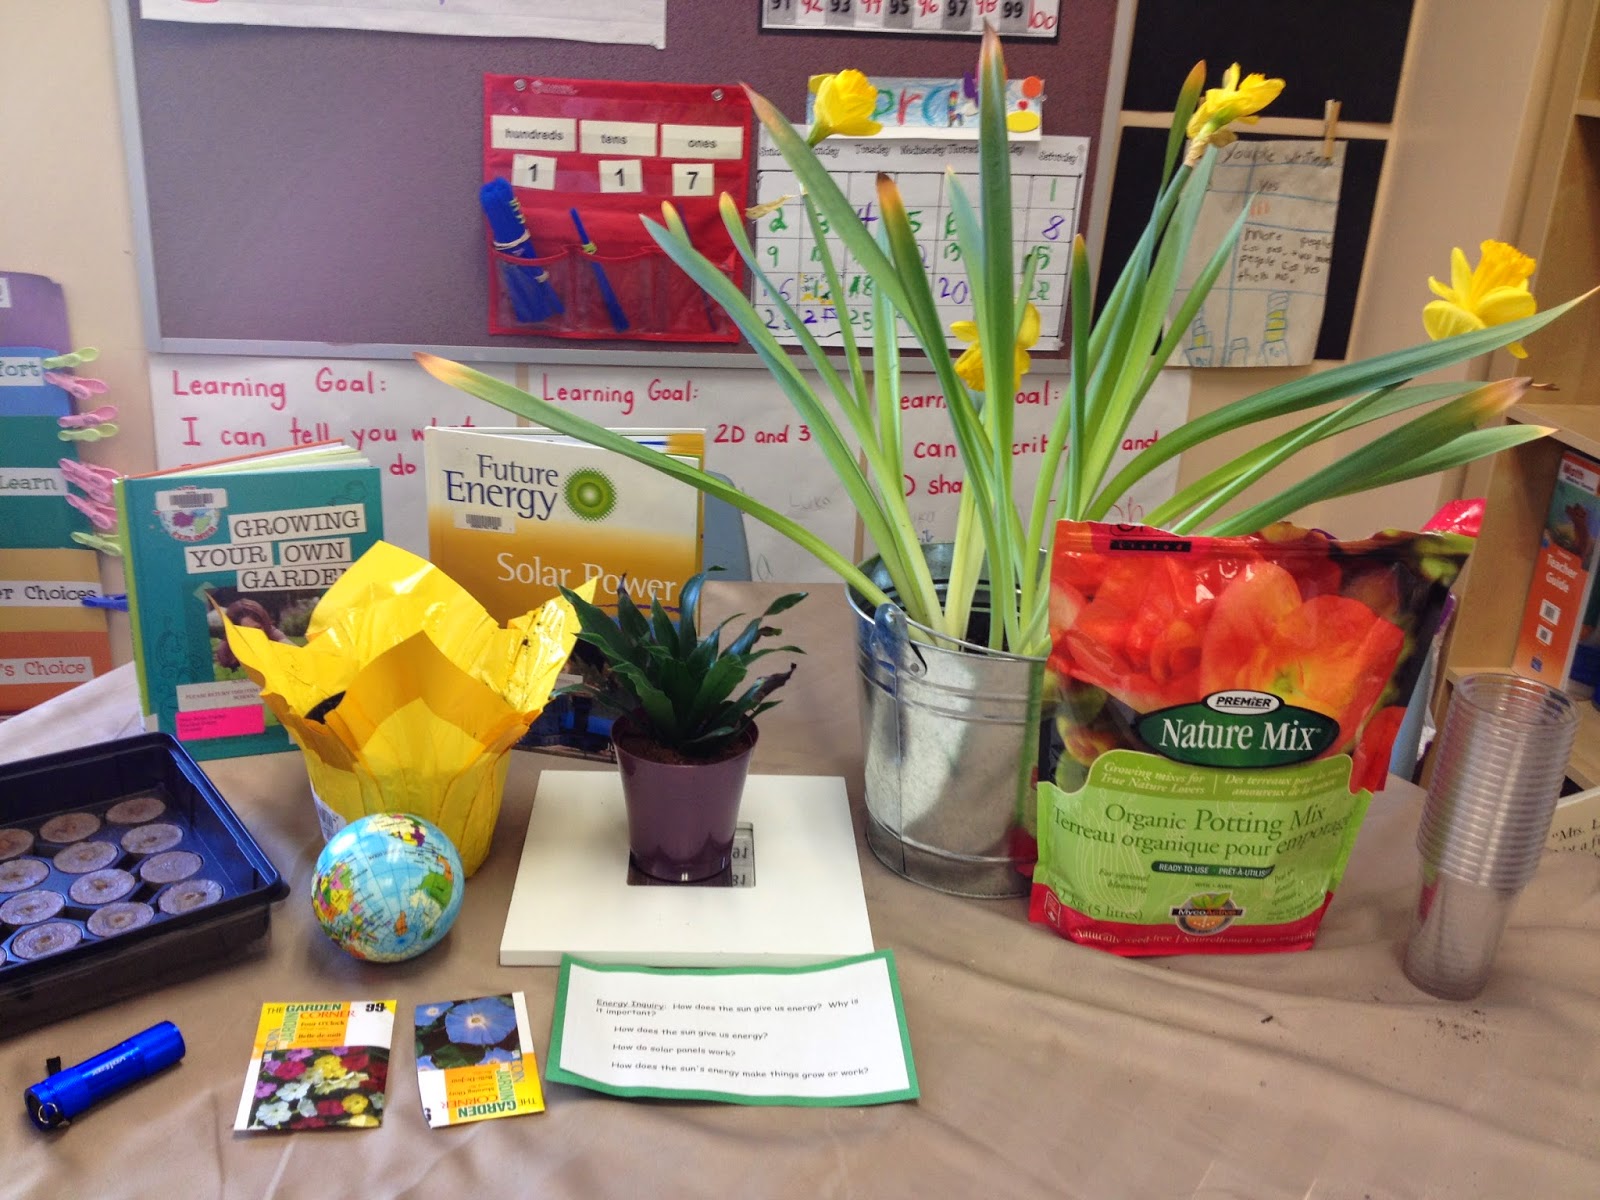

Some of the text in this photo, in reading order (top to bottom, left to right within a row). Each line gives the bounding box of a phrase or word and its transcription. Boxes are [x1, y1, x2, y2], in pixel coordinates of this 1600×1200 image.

[1002, 2, 1023, 18] 99
[1027, 0, 1057, 29] 100
[504, 127, 565, 141] hundreds
[600, 134, 628, 145] tens
[687, 139, 718, 150] ones
[528, 163, 539, 182] 1
[614, 168, 626, 187] 1
[686, 171, 699, 190] 7
[1042, 215, 1065, 241] 8
[767, 246, 779, 268] 9
[938, 277, 969, 304] 20
[172, 366, 388, 410] Learning Goal:
[542, 372, 699, 416] Learning Goal:
[1015, 379, 1060, 406] oal:
[181, 416, 398, 451] I can tell you
[713, 423, 789, 444] 2D and
[913, 429, 1159, 459] can and
[389, 452, 416, 476] do
[476, 453, 560, 488] Future
[442, 469, 558, 521] Energy
[234, 510, 361, 538] GROWING
[189, 545, 268, 568] YOUR
[283, 541, 345, 563] OWN
[496, 552, 572, 588] Solar
[581, 562, 678, 602] Power
[24, 586, 98, 603] Choices
[24, 661, 86, 676] Choice
[1159, 718, 1253, 750] Nature
[1103, 762, 1153, 781] Growing
[1225, 774, 1244, 784] Des
[1101, 773, 1206, 794] True Nature Lovers
[1105, 803, 1327, 841] Organic Potting Mix
[1053, 805, 1116, 844] Terreau
[1121, 835, 1220, 858] organique
[1223, 841, 1273, 861] pour
[1158, 863, 1210, 874] READY-TO-USE
[286, 1003, 342, 1013] GARDEN
[300, 1010, 357, 1019] CORNER
[595, 998, 629, 1008] Energy
[695, 1003, 716, 1012] does
[719, 1004, 733, 1012] the
[753, 1005, 772, 1013] give
[786, 1003, 822, 1013] energy?
[828, 1000, 849, 1009] Why
[606, 1008, 657, 1017] important?
[613, 1025, 634, 1033] How
[636, 1026, 659, 1035] does
[661, 1028, 678, 1036] the
[698, 1029, 717, 1038] give
[732, 1032, 769, 1040] energy?
[612, 1043, 634, 1051] How
[650, 1046, 674, 1054] solar
[676, 1047, 706, 1055] panels
[708, 1048, 737, 1057] work?
[611, 1060, 633, 1069] How
[635, 1062, 658, 1070] does
[661, 1064, 678, 1072] the
[680, 1064, 705, 1072] sun's
[707, 1067, 740, 1077] energy
[742, 1070, 767, 1078] make
[770, 1069, 800, 1079] things
[802, 1072, 825, 1080] grow
[840, 1067, 870, 1077] work?
[440, 1095, 499, 1110] CORNER
[457, 1100, 517, 1118] GARDEN
[519, 1098, 537, 1107] THE
